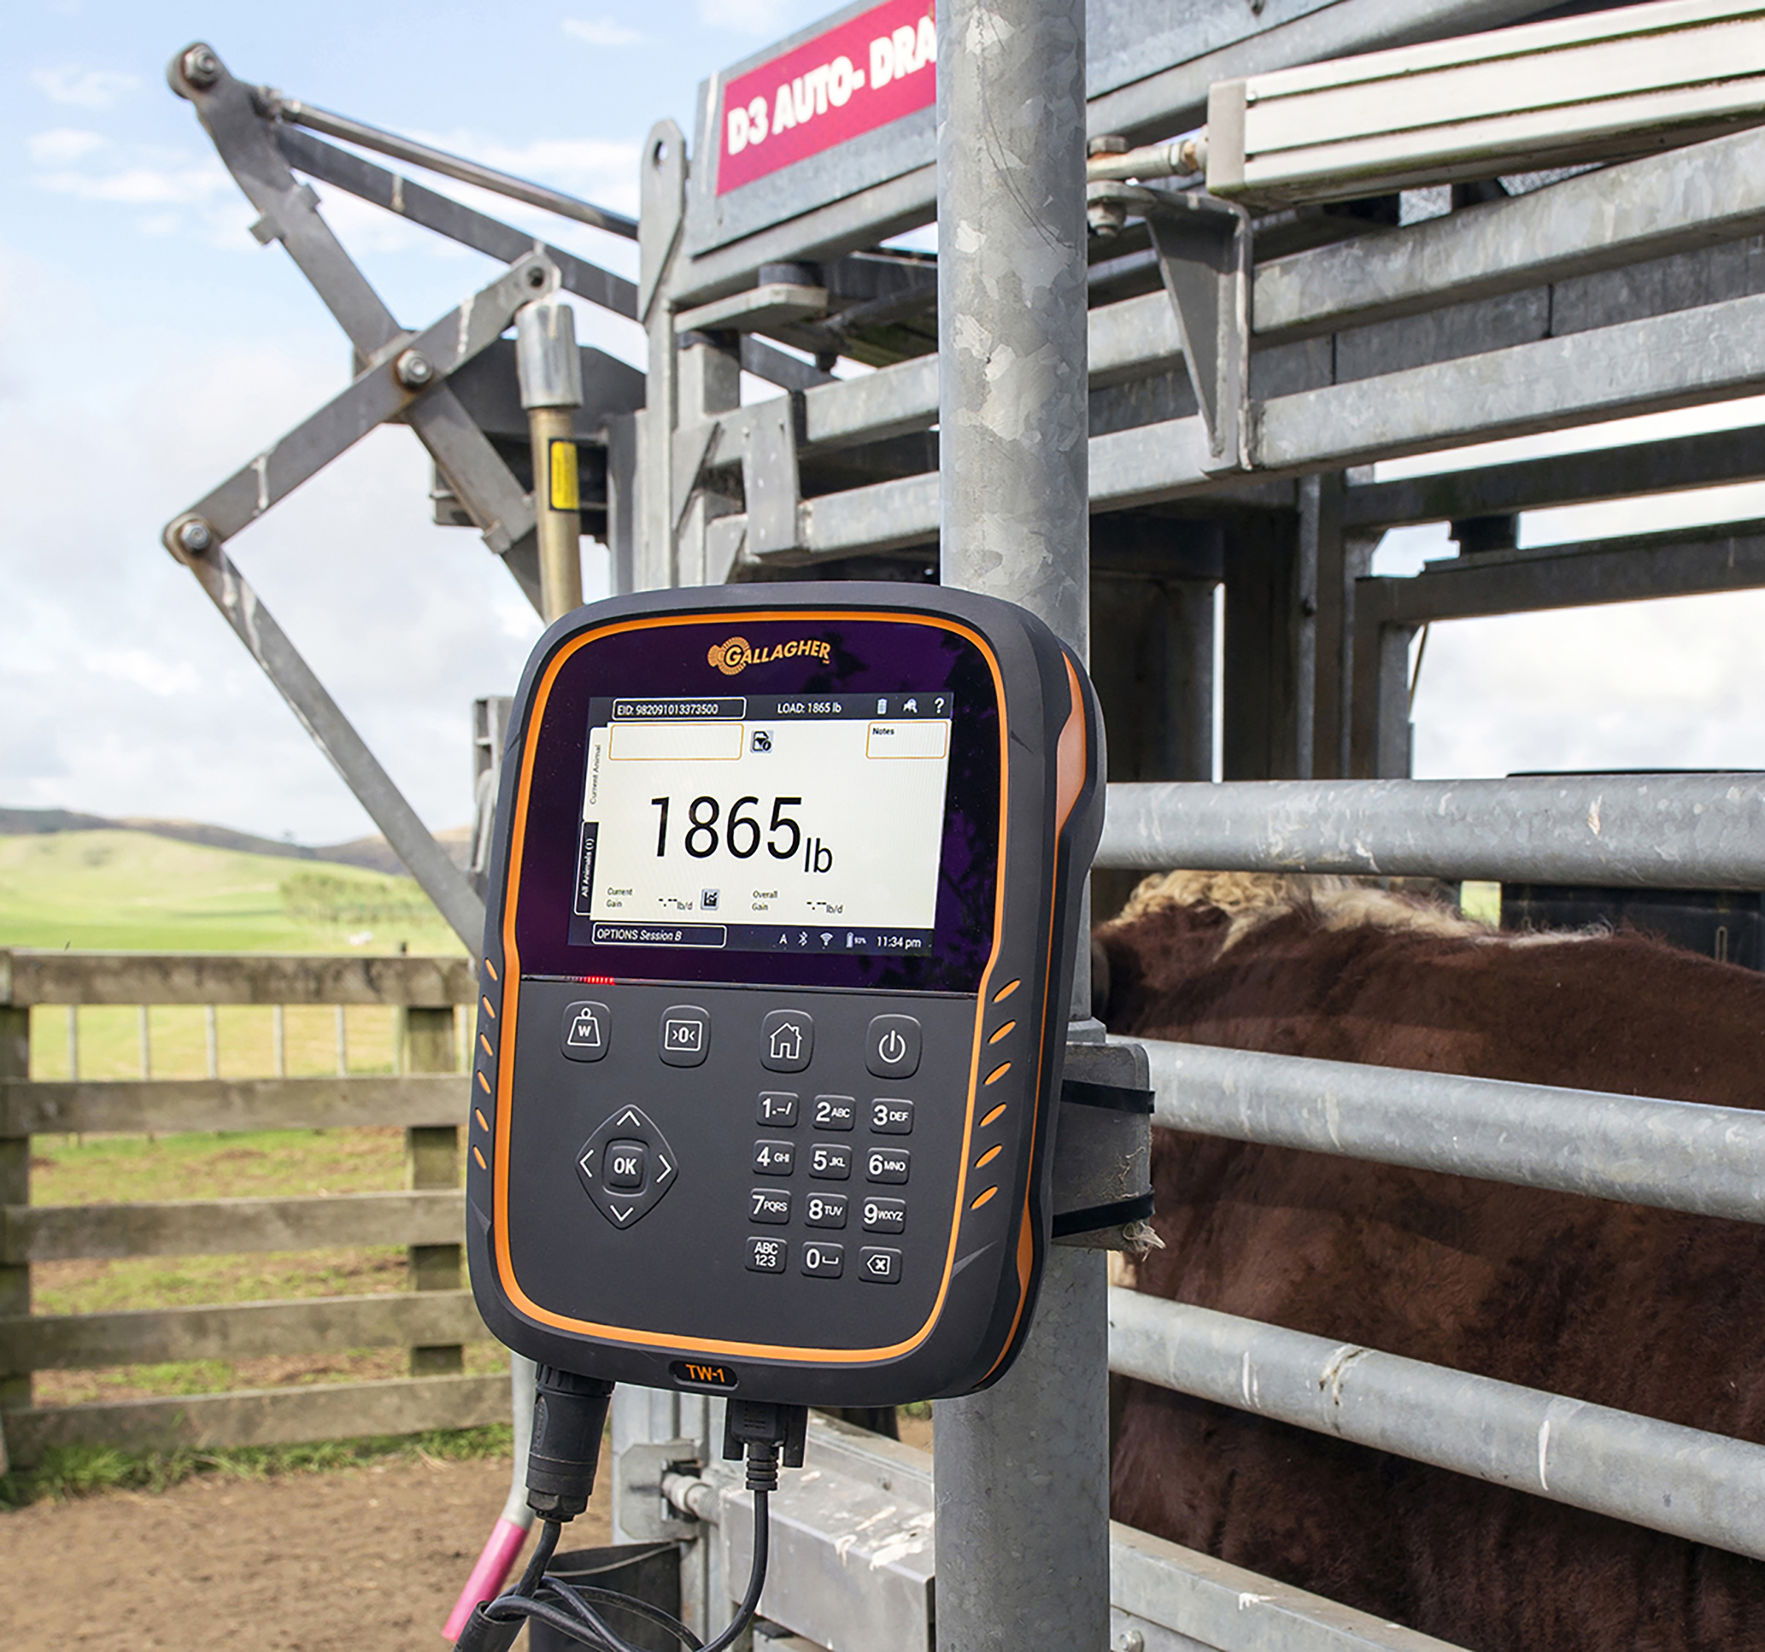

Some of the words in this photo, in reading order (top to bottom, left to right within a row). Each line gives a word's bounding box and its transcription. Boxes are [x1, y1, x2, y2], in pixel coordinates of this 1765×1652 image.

[727, 96, 768, 155] D3
[772, 56, 865, 135] AUTO-
[725, 640, 831, 665] GALLAGHER
[617, 704, 634, 715] EID:
[777, 702, 805, 714] LOAD:
[808, 702, 830, 713] 1865
[832, 702, 842, 713] lb
[872, 727, 895, 736] Notes
[651, 796, 802, 859] 1865
[804, 837, 833, 873] lb
[607, 887, 633, 896] Current
[752, 890, 778, 899] Overall
[606, 900, 622, 908] Gain
[752, 903, 768, 911] Gain
[597, 929, 638, 940] OPTIONS
[640, 929, 673, 941] Session
[779, 933, 787, 944] A
[877, 936, 903, 948] 11:34
[905, 938, 921, 949] pm
[578, 1025, 591, 1037] W
[613, 1157, 637, 1175] OK
[754, 1242, 778, 1254] ABC
[755, 1254, 776, 1267] 123
[685, 1364, 725, 1382] TW-1
